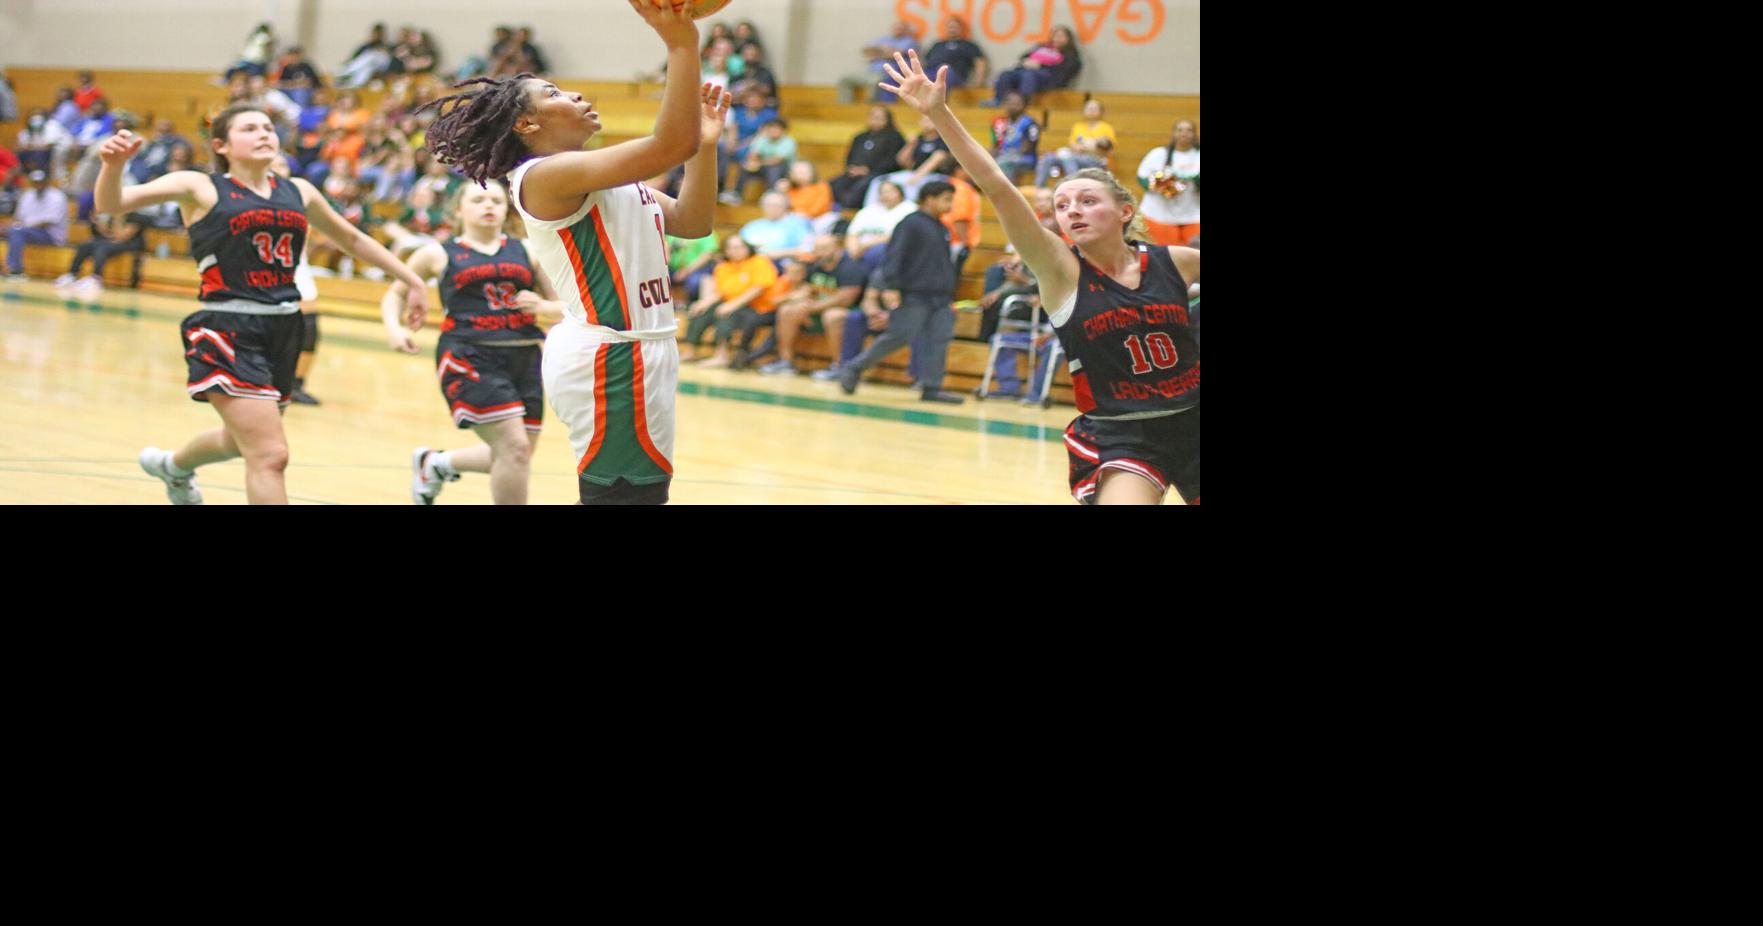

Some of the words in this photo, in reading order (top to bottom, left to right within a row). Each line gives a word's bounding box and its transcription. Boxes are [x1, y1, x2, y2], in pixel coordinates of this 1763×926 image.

[252, 232, 294, 268] 34
[484, 282, 519, 311] 12
[1083, 308, 1140, 341] CHATHAM
[1123, 331, 1179, 375] 10
